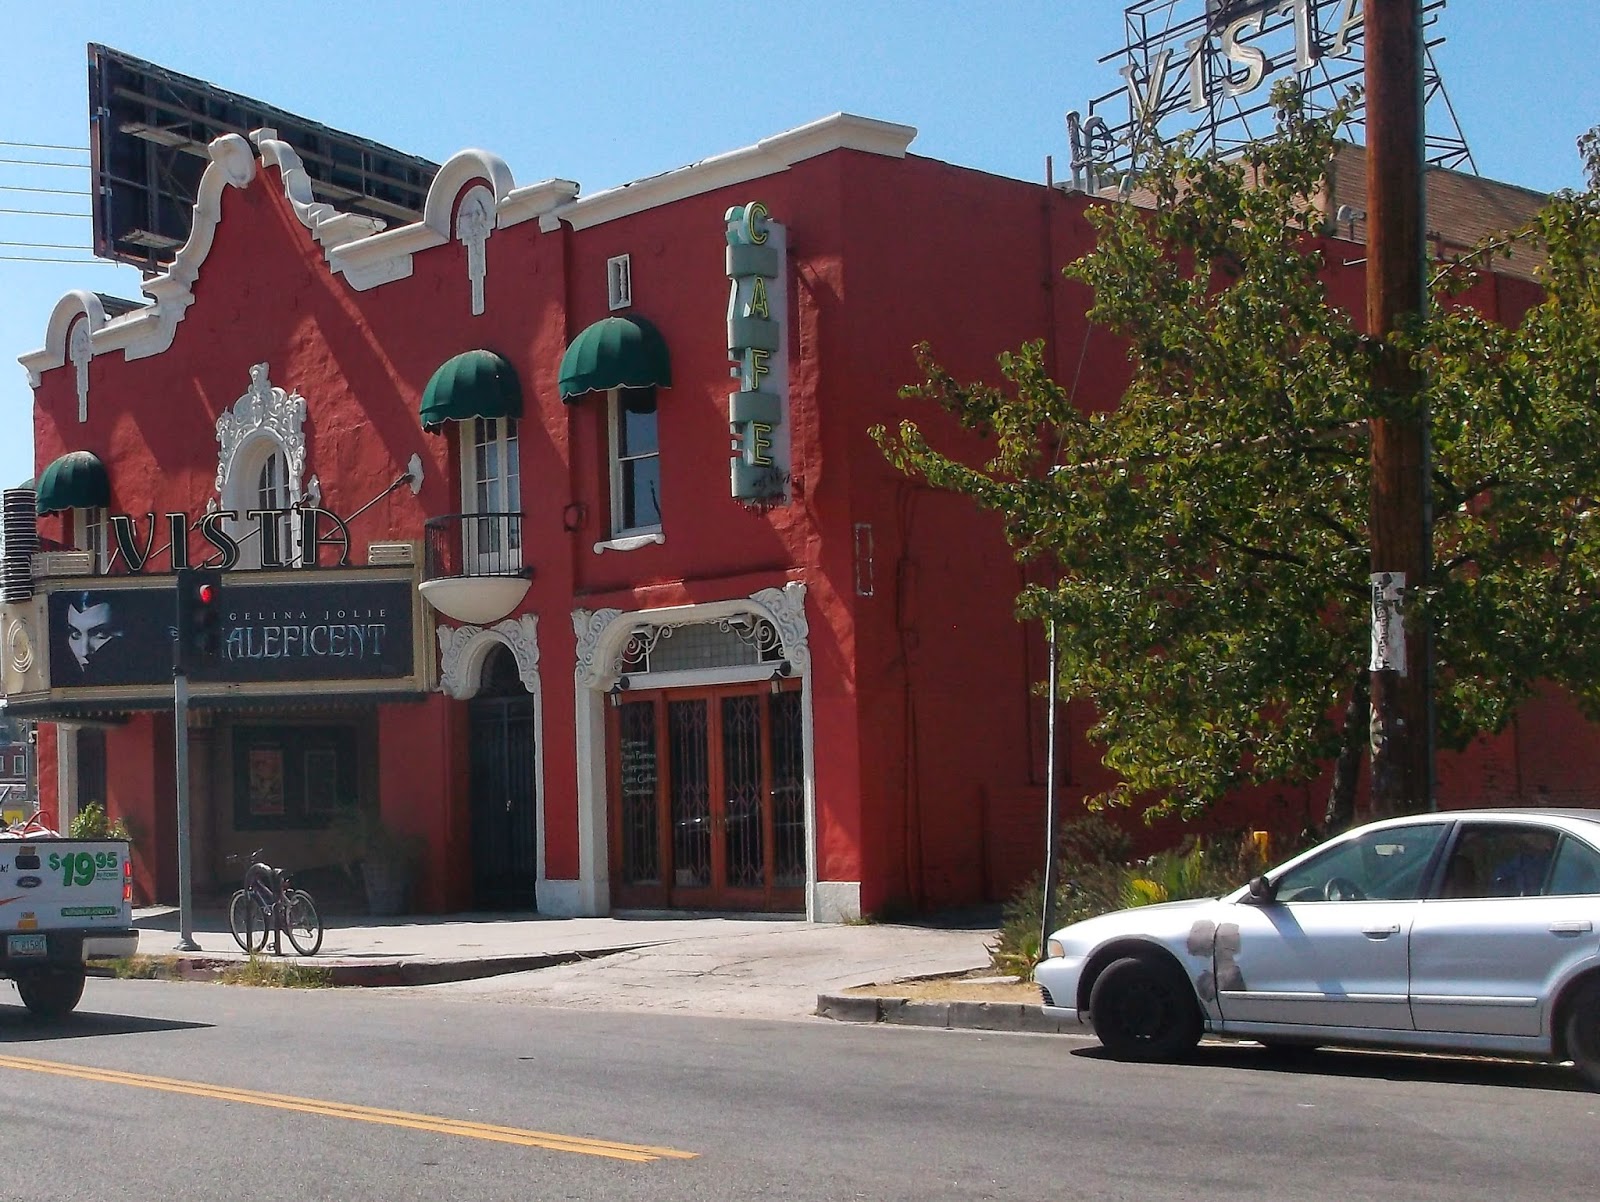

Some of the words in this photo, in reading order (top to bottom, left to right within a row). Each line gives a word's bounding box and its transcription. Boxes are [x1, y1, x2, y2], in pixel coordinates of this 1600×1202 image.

[744, 201, 772, 467] CAFE
[109, 506, 350, 573] VISTA
[229, 612, 307, 621] GELINA
[324, 609, 386, 620] JOLIE
[221, 624, 386, 661] ALEFICENT
